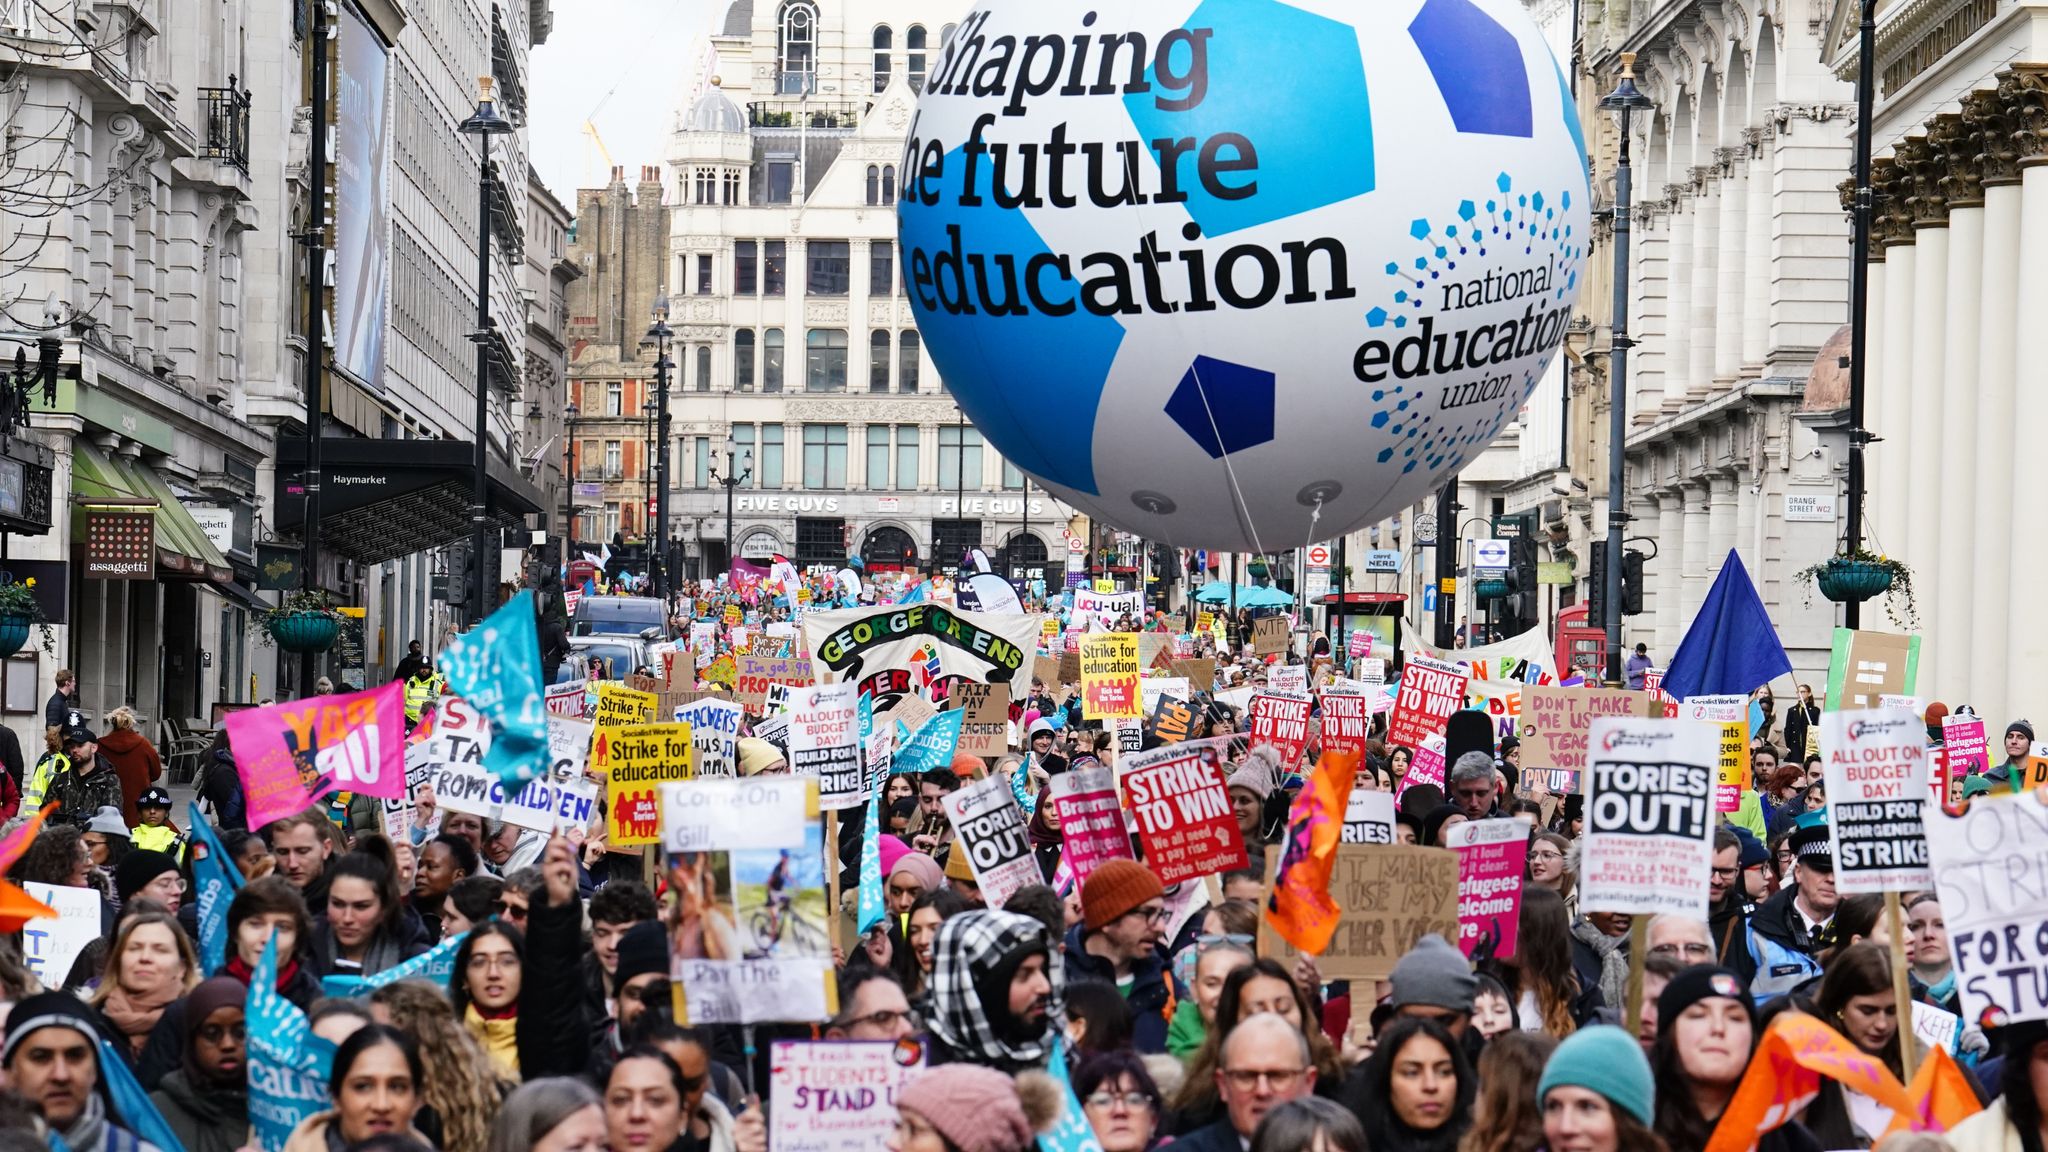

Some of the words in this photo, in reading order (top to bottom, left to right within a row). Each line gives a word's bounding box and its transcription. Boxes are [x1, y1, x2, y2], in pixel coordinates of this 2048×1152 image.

[926, 12, 1213, 115] Shaping
[958, 114, 1258, 209] future
[912, 222, 1355, 316] education
[1441, 253, 1553, 311] national
[1352, 301, 1571, 382] education
[1440, 373, 1510, 411] union
[333, 475, 386, 485] Haymarket
[738, 496, 780, 511] FIVE
[785, 497, 838, 512] GUYS
[941, 499, 983, 513] FIVE
[989, 499, 1042, 514] GUYS
[199, 521, 227, 529] aghetti
[90, 561, 147, 574] assaggetti
[753, 636, 768, 645] Our
[824, 606, 924, 662] GEORGE
[932, 611, 1022, 670] GREENS
[753, 646, 776, 657] ROOF
[1083, 644, 1116, 659] Strike
[1120, 643, 1136, 658] for
[767, 662, 788, 677] got
[796, 662, 810, 676] 99
[1084, 660, 1137, 674] education
[1414, 657, 1439, 669] Socialist
[1440, 664, 1462, 675] Worker
[1500, 656, 1552, 686] PARK
[634, 676, 656, 692] FOR
[957, 684, 990, 696] FAIR
[1404, 666, 1464, 699] STRIKE
[546, 692, 585, 714] STRIKE
[609, 690, 630, 698] Socialist
[962, 698, 985, 708] PAY
[1264, 690, 1286, 698] Socialist
[1286, 692, 1306, 700] Worker
[1400, 687, 1422, 710] TO
[1425, 693, 1460, 718] WIN
[600, 696, 634, 716] Strike
[1257, 698, 1308, 722] STRIKE
[1324, 698, 1362, 717] STRIKE
[1532, 696, 1578, 712] DON'T
[1588, 696, 1632, 714] MAKE
[795, 712, 817, 724] ALL
[818, 710, 841, 722] OUT
[1399, 710, 1409, 721] We
[1410, 714, 1420, 724] all
[1420, 717, 1438, 728] need
[1538, 712, 1560, 729] ME
[621, 730, 654, 738] Socialist
[654, 728, 679, 736] Worker
[806, 722, 850, 736] BUDGET
[1255, 717, 1273, 736] TO
[1277, 720, 1306, 741] WIN
[1324, 717, 1338, 736] TO
[1342, 718, 1364, 738] WIN
[1402, 723, 1414, 733] pay
[816, 735, 842, 747] DAY!
[958, 736, 992, 750] STAY
[1394, 731, 1414, 743] Strike
[1947, 736, 1984, 748] Refugees
[612, 739, 658, 760] Strike
[665, 738, 688, 758] for
[796, 750, 830, 763] BUILD
[830, 748, 850, 761] FOR
[1419, 749, 1434, 762] Say
[1832, 750, 1859, 764] ALL
[1864, 748, 1900, 762] OUT
[1902, 746, 1922, 760] ON
[1948, 746, 1984, 756] welcome
[1128, 752, 1169, 770] Socialist
[1415, 757, 1429, 770] Say
[1950, 758, 1968, 768] here
[612, 761, 688, 782] education
[1526, 768, 1550, 787] PAY
[1550, 770, 1570, 790] UP
[1596, 764, 1708, 797] TORIES
[1846, 764, 1912, 781] BUDGET
[429, 762, 488, 802] FROM
[1128, 758, 1222, 804] STRIKE
[749, 784, 781, 807] On
[1864, 783, 1902, 798] DAY!
[1136, 799, 1174, 834] TO
[1175, 786, 1231, 825] WIN
[1593, 792, 1706, 836] OUT!
[1836, 804, 1884, 822] BUILD
[1884, 802, 1918, 820] FOR
[676, 824, 716, 850] Gill,
[1152, 837, 1169, 851] We
[1172, 830, 1185, 846] all
[1186, 824, 1212, 842] need
[1838, 824, 1873, 840] 24HR
[1157, 852, 1165, 863] a
[1166, 847, 1186, 863] pay
[1187, 842, 1208, 855] rise
[1480, 845, 1504, 858] loud
[1841, 840, 1929, 868] STRIKE
[1162, 864, 1194, 880] Strike
[1195, 852, 1238, 872] together
[1380, 854, 1454, 886] MAKE
[1479, 860, 1509, 872] clear:
[1603, 862, 1645, 873] BUILD
[1660, 863, 1689, 876] NEW
[1661, 874, 1702, 889] PARTY
[1401, 882, 1452, 915] MY
[1954, 924, 2026, 973] FOR
[694, 962, 730, 986] Pay
[737, 960, 781, 984] The
[700, 1001, 742, 1020] Bill
[778, 1044, 795, 1062] I
[780, 1066, 890, 1085] STUDENTS
[793, 1086, 876, 1112] STAND
